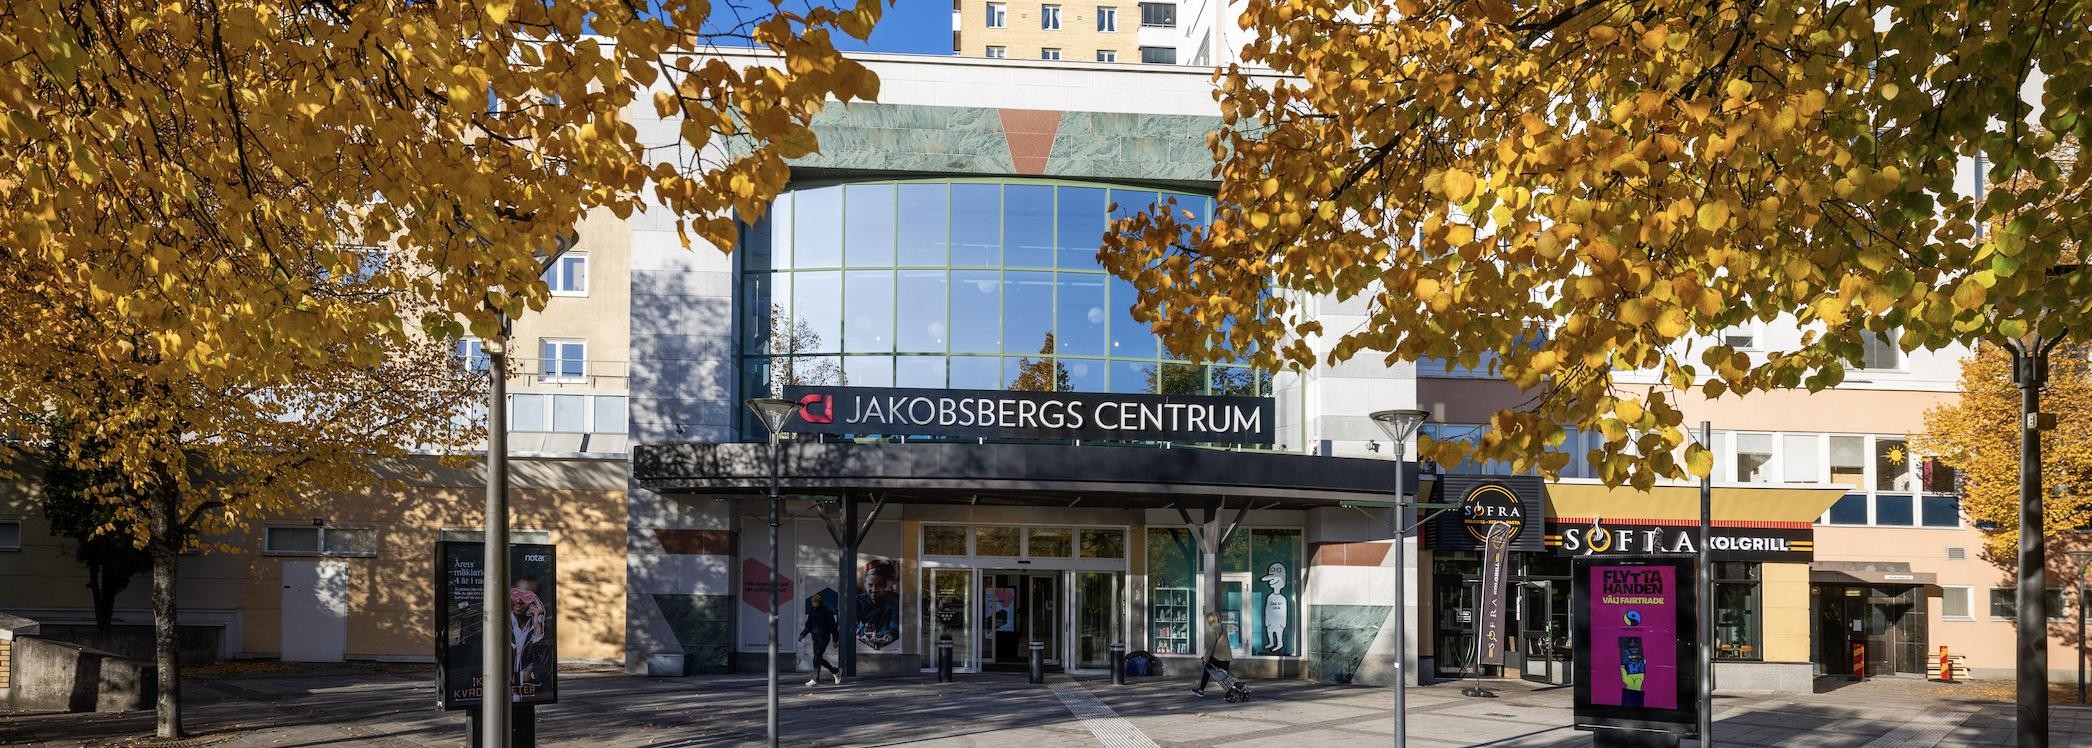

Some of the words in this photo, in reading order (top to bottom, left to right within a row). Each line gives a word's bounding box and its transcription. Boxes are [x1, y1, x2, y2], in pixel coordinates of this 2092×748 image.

[846, 395, 1083, 429] JAKOBSBERGS
[1094, 401, 1261, 434] CENTRUM
[1464, 503, 1521, 518] SOFRA
[454, 558, 474, 568] Årets
[525, 554, 545, 562] notar
[461, 576, 469, 584] år
[1603, 570, 1662, 583] FLYTTA
[1603, 583, 1663, 594] HANDEN
[1602, 594, 1620, 605] VÄLJ
[1620, 596, 1664, 605] FAIRTRADE
[1488, 599, 1498, 649] SOFRA
